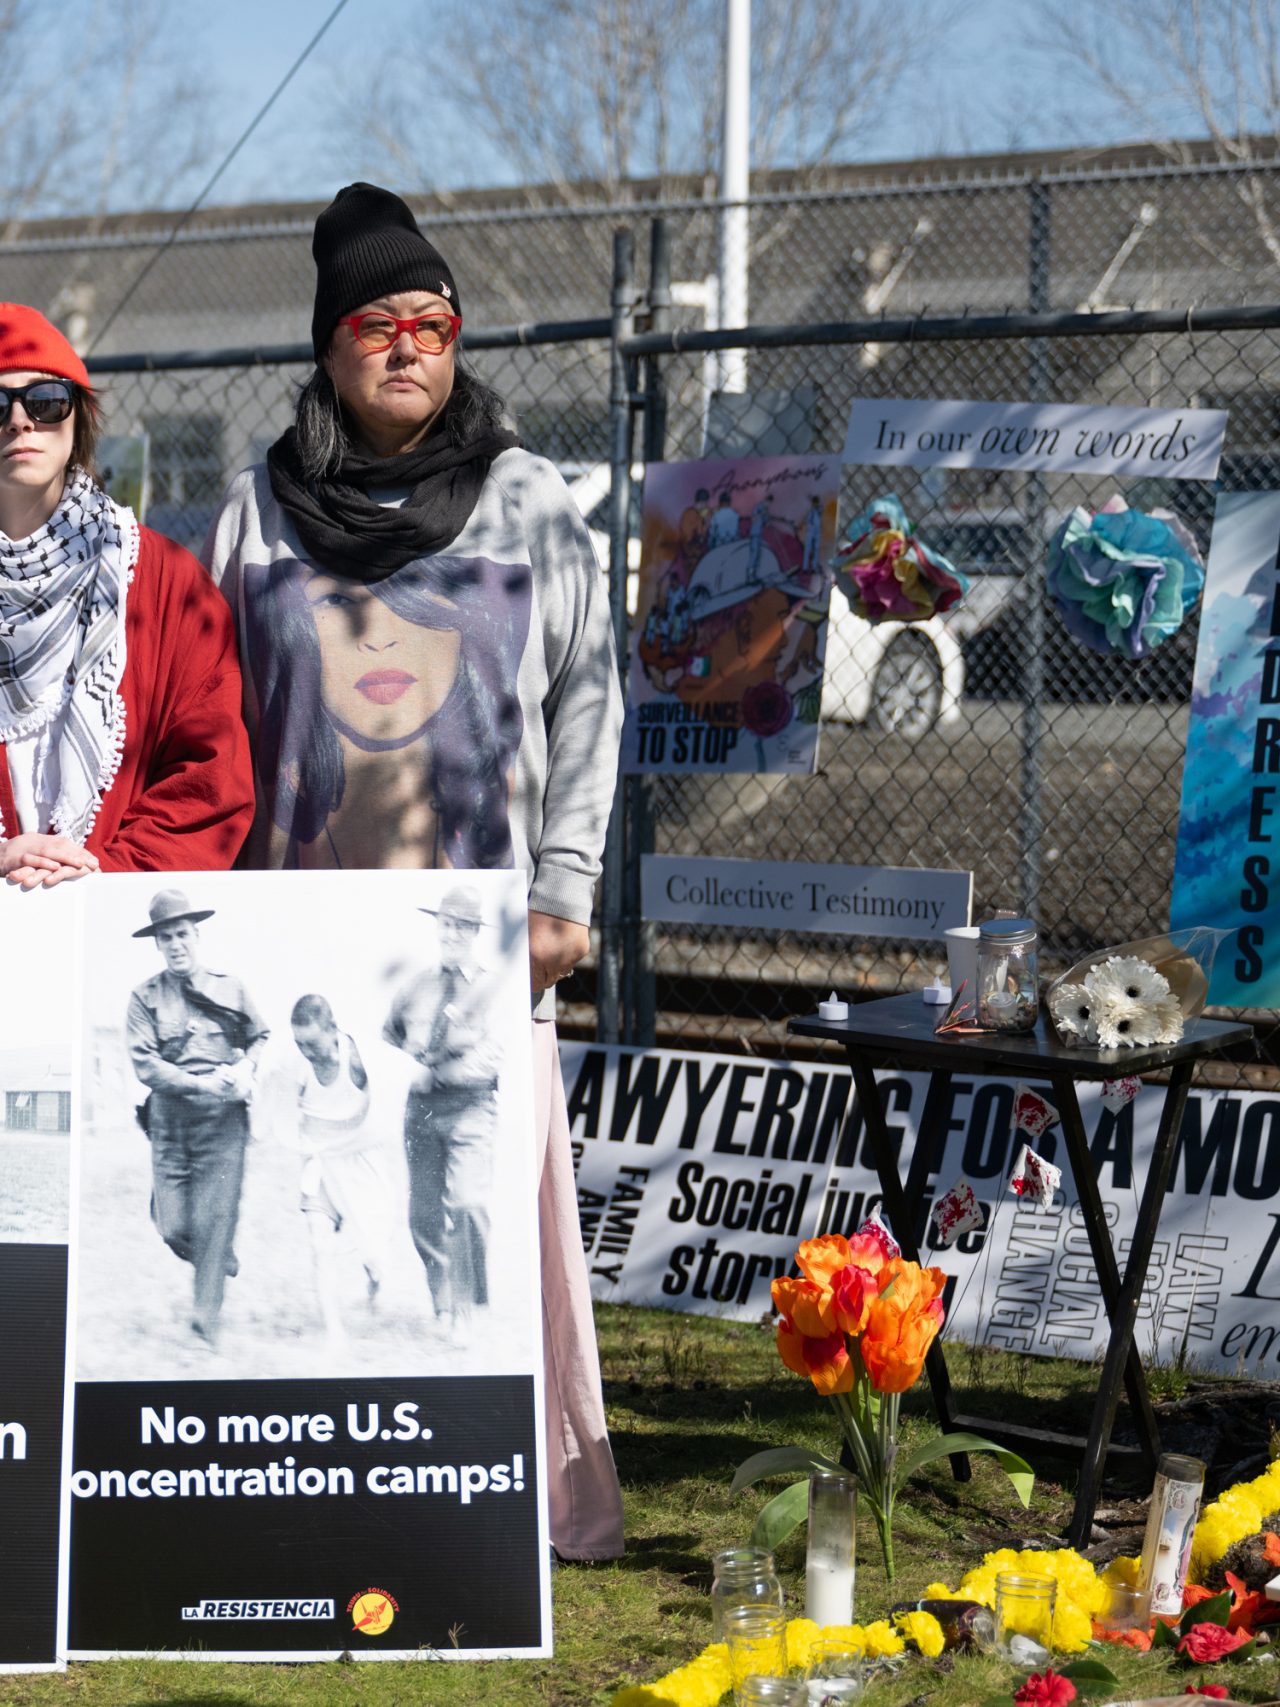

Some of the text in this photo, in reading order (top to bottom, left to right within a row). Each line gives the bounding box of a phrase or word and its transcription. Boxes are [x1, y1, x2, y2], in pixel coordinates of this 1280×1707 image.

[874, 418, 1196, 463] In our own words
[637, 727, 738, 764] TO STOP
[666, 874, 946, 930] Collective Testimony
[567, 1050, 913, 1172] AWYERING
[667, 1160, 813, 1237] Social
[591, 1166, 651, 1285] FAMILY
[140, 1400, 433, 1444] No more U.S.
[72, 1453, 526, 1505] oncentration camps!
[184, 1601, 331, 1618] LA RESISTENCIA
